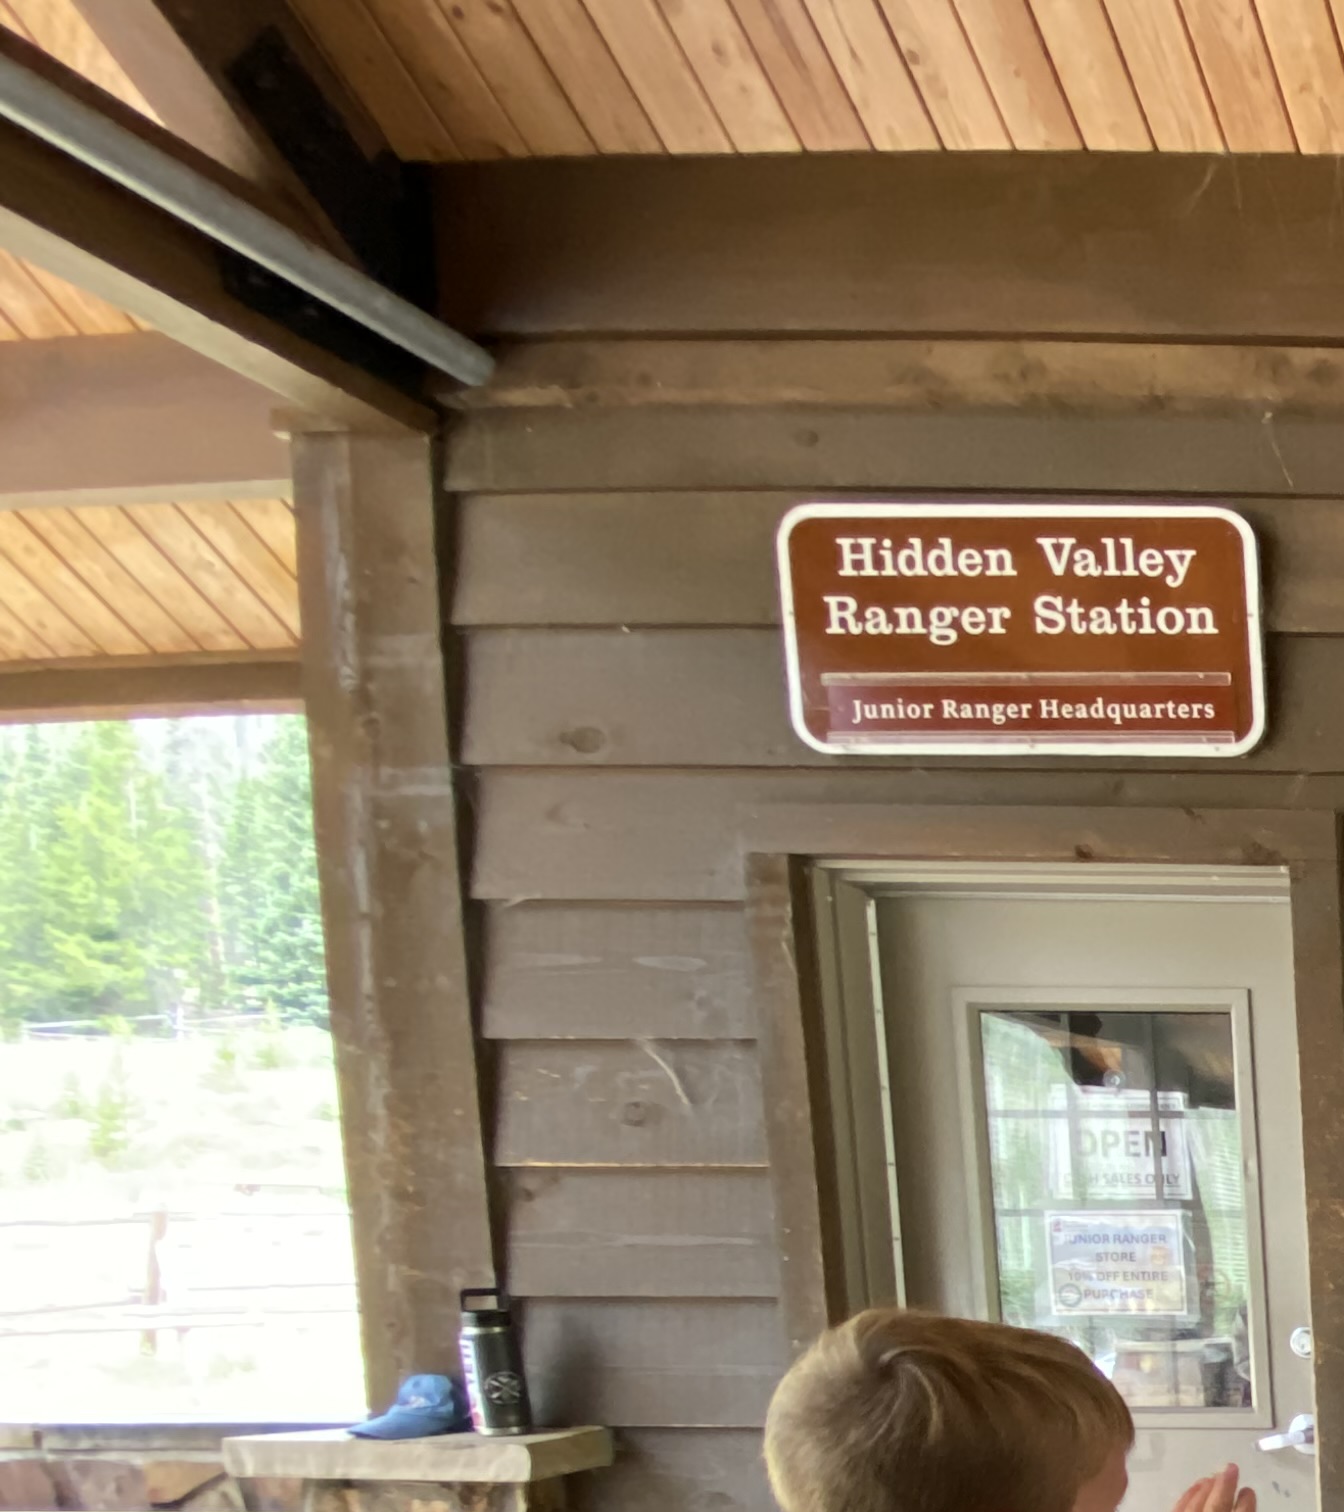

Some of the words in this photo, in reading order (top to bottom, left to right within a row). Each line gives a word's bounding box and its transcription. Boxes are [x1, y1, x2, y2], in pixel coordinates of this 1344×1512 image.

[835, 537, 1018, 577] Hidden
[1035, 537, 1197, 588] Valley
[823, 595, 1012, 646] Ranger
[1034, 595, 1220, 635] Station
[852, 698, 935, 724] Junior
[941, 699, 1033, 725] Ranger
[1039, 697, 1216, 725] Headquarters
[1075, 1130, 1167, 1157] OPEN
[1103, 1173, 1141, 1185] SALES
[1113, 1233, 1167, 1245] RANGER
[1095, 1251, 1137, 1263] STORE
[1122, 1270, 1169, 1281] ENTIRE
[1084, 1288, 1154, 1300] PURCHASE
